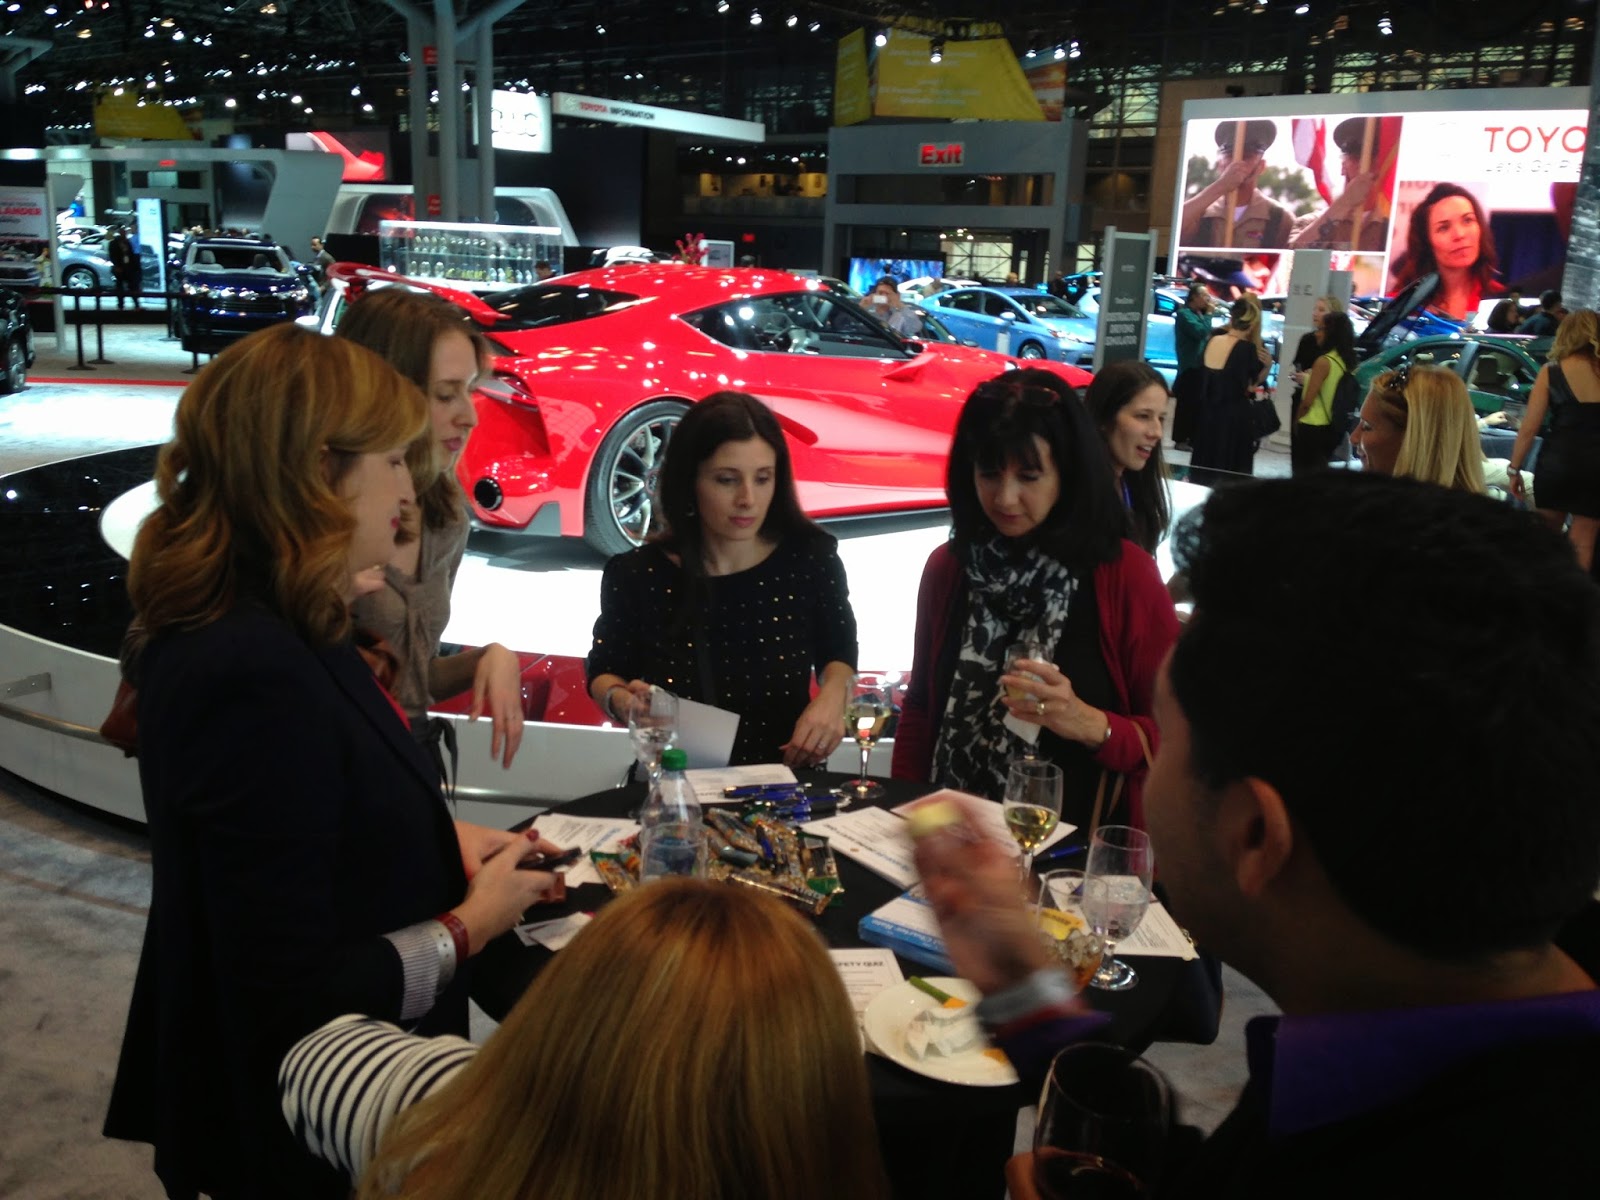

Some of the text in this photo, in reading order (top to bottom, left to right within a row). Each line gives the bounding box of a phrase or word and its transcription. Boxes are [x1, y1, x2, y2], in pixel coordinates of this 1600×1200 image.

[580, 102, 655, 119] TOYOTA INFORMATION
[921, 144, 963, 165] Exit
